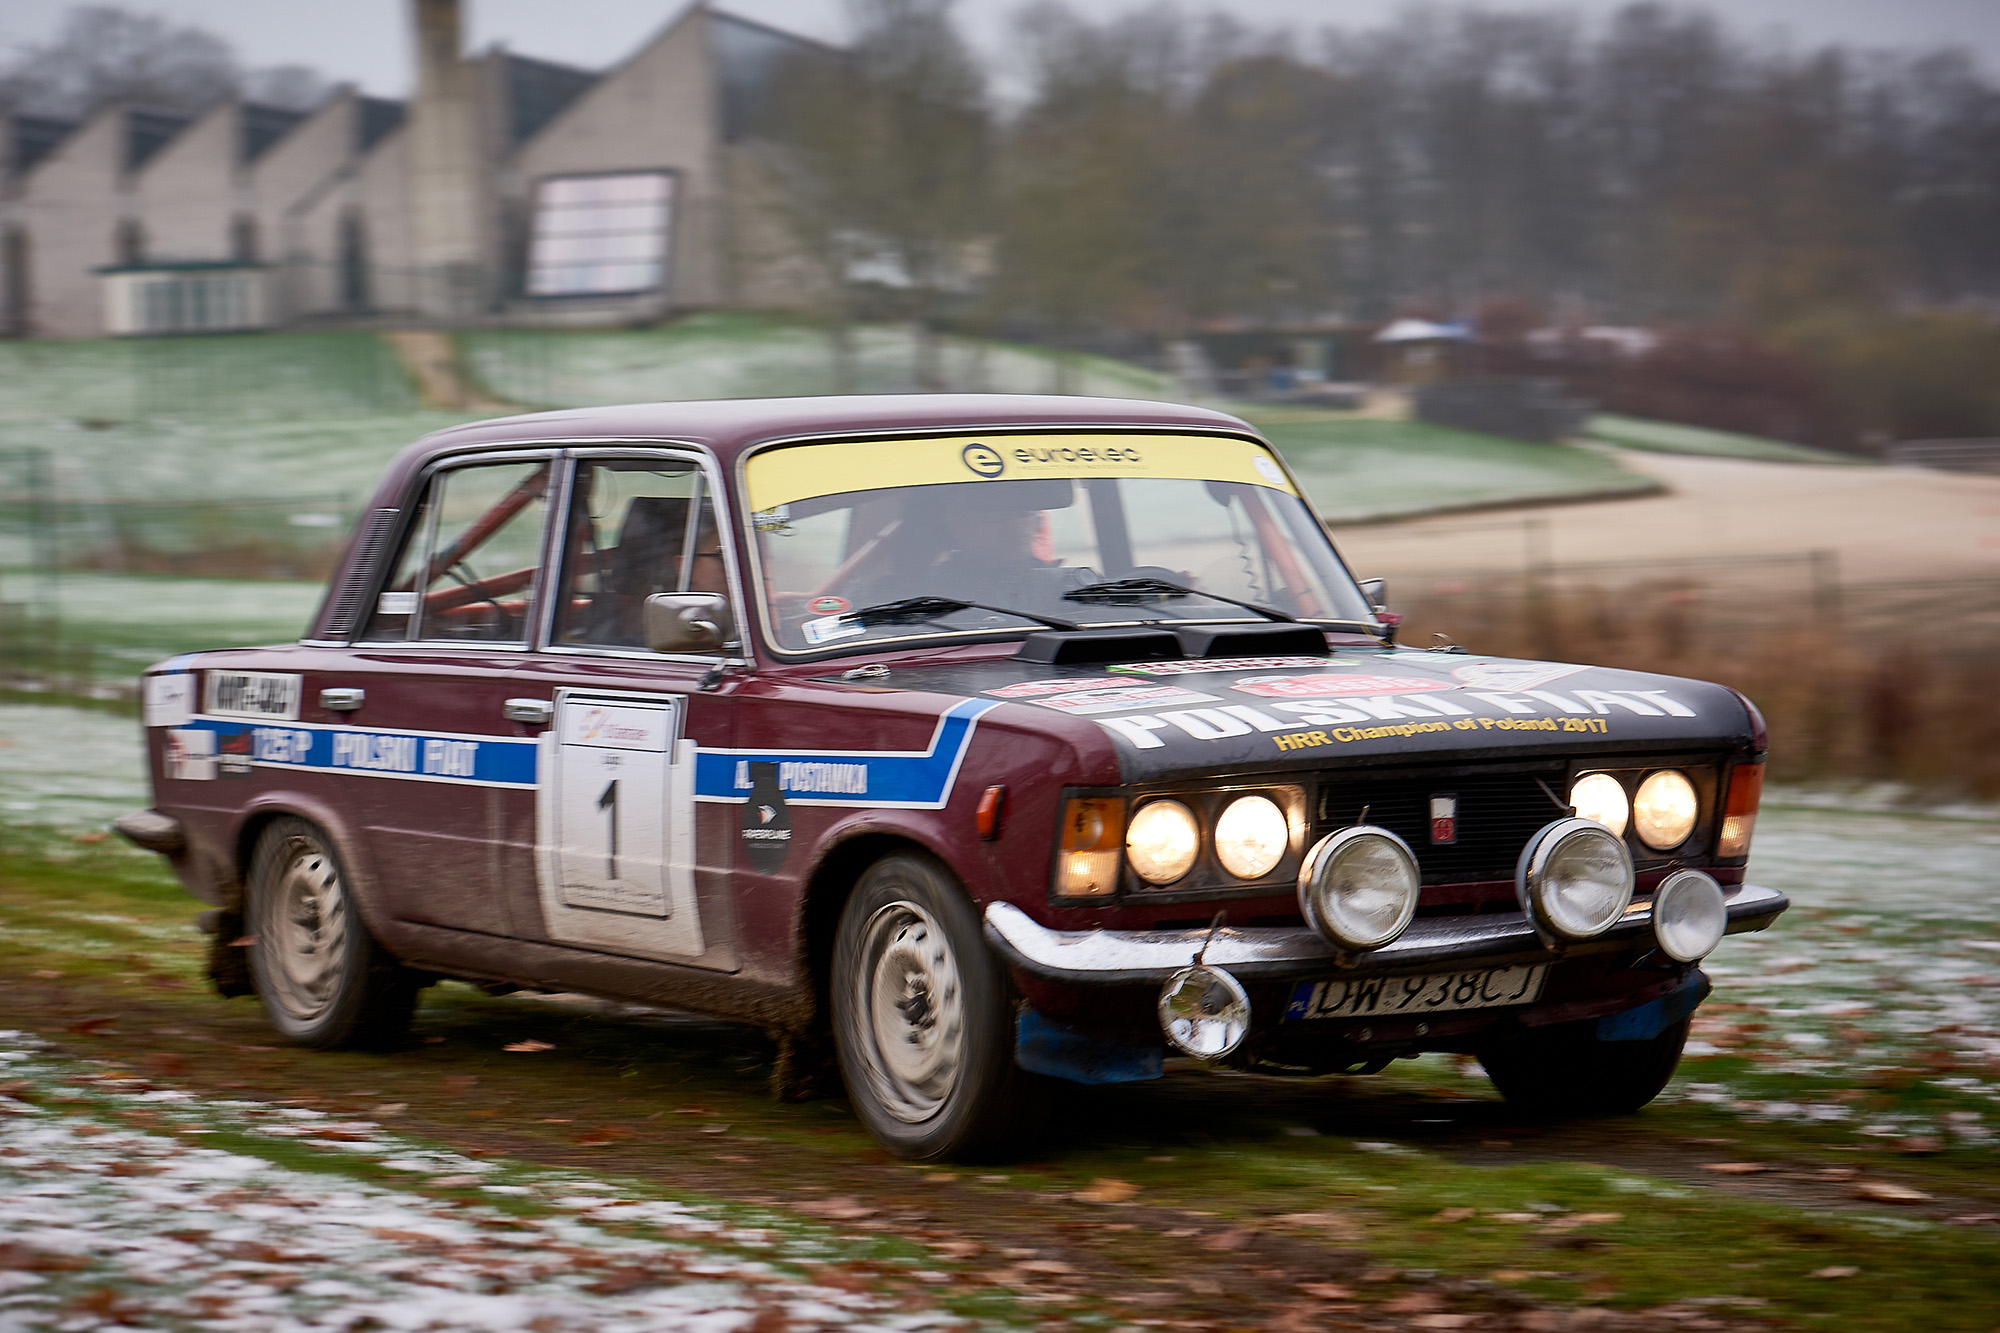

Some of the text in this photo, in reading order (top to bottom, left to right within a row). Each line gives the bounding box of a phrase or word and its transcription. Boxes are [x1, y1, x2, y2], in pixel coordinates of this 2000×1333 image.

[1015, 447, 1142, 463] euroelec
[1093, 694, 1474, 748] POLSKI
[1464, 689, 1697, 717] FIAT
[1272, 716, 1609, 751] HRR Champion of Poland 2017
[332, 732, 418, 772] POLSKI
[423, 739, 480, 777] FIAT
[778, 761, 868, 794] POSTAWKA
[596, 779, 621, 880] 1
[1288, 1000, 1306, 1012] PL
[1316, 976, 1388, 1014] DW
